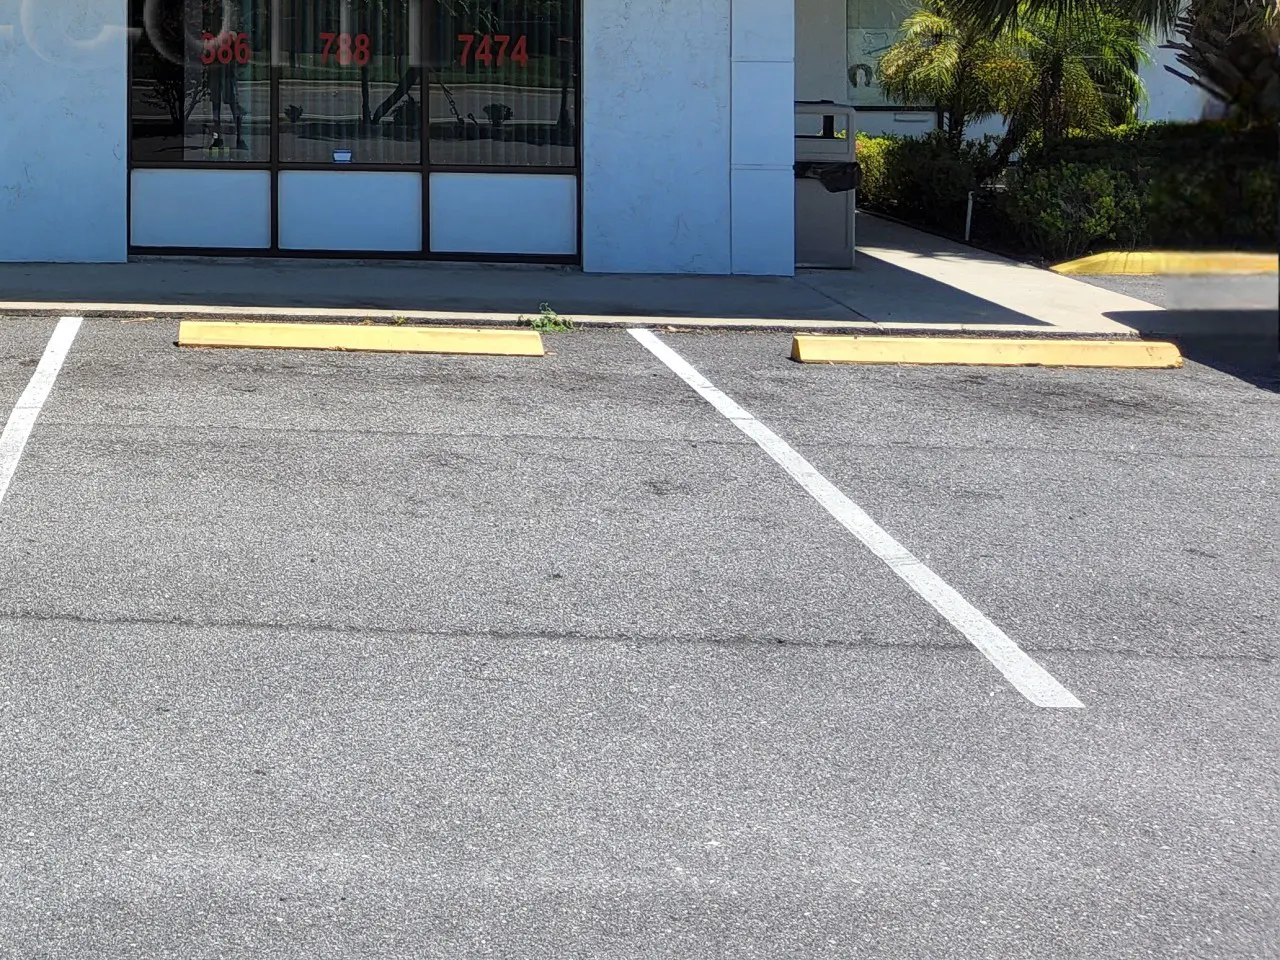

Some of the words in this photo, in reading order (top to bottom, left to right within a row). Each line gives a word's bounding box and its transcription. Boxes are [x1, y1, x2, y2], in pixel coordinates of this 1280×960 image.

[200, 32, 250, 65] 386
[320, 32, 371, 65] 788
[457, 34, 529, 66] 7474
